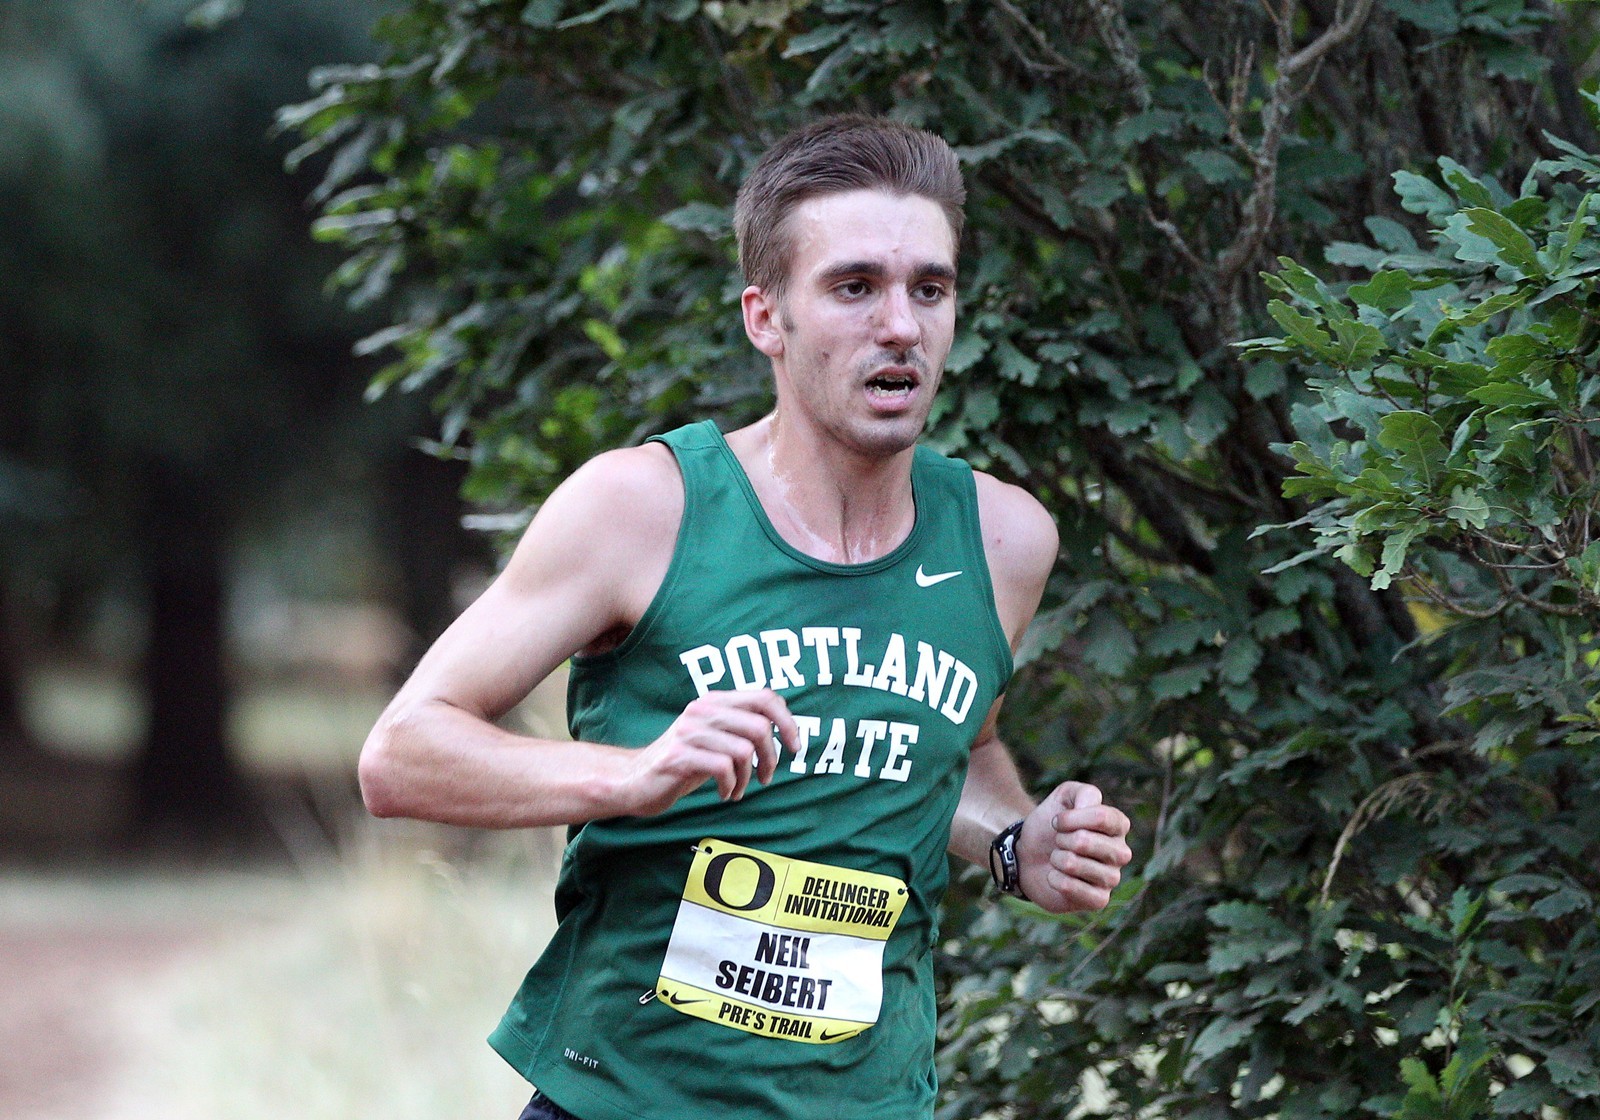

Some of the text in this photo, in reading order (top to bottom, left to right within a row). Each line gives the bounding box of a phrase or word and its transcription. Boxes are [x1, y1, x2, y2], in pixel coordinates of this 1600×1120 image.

[679, 626, 979, 725] PORTLAND
[703, 852, 776, 912] O
[801, 876, 890, 910] DELLINGER
[783, 894, 894, 928] INVITATIONAL
[754, 932, 811, 970] NEIL
[715, 960, 833, 1011] SEIBERT
[717, 1002, 813, 1039] PRE'S TRAIL
[563, 1047, 599, 1069] DRI-FIT
